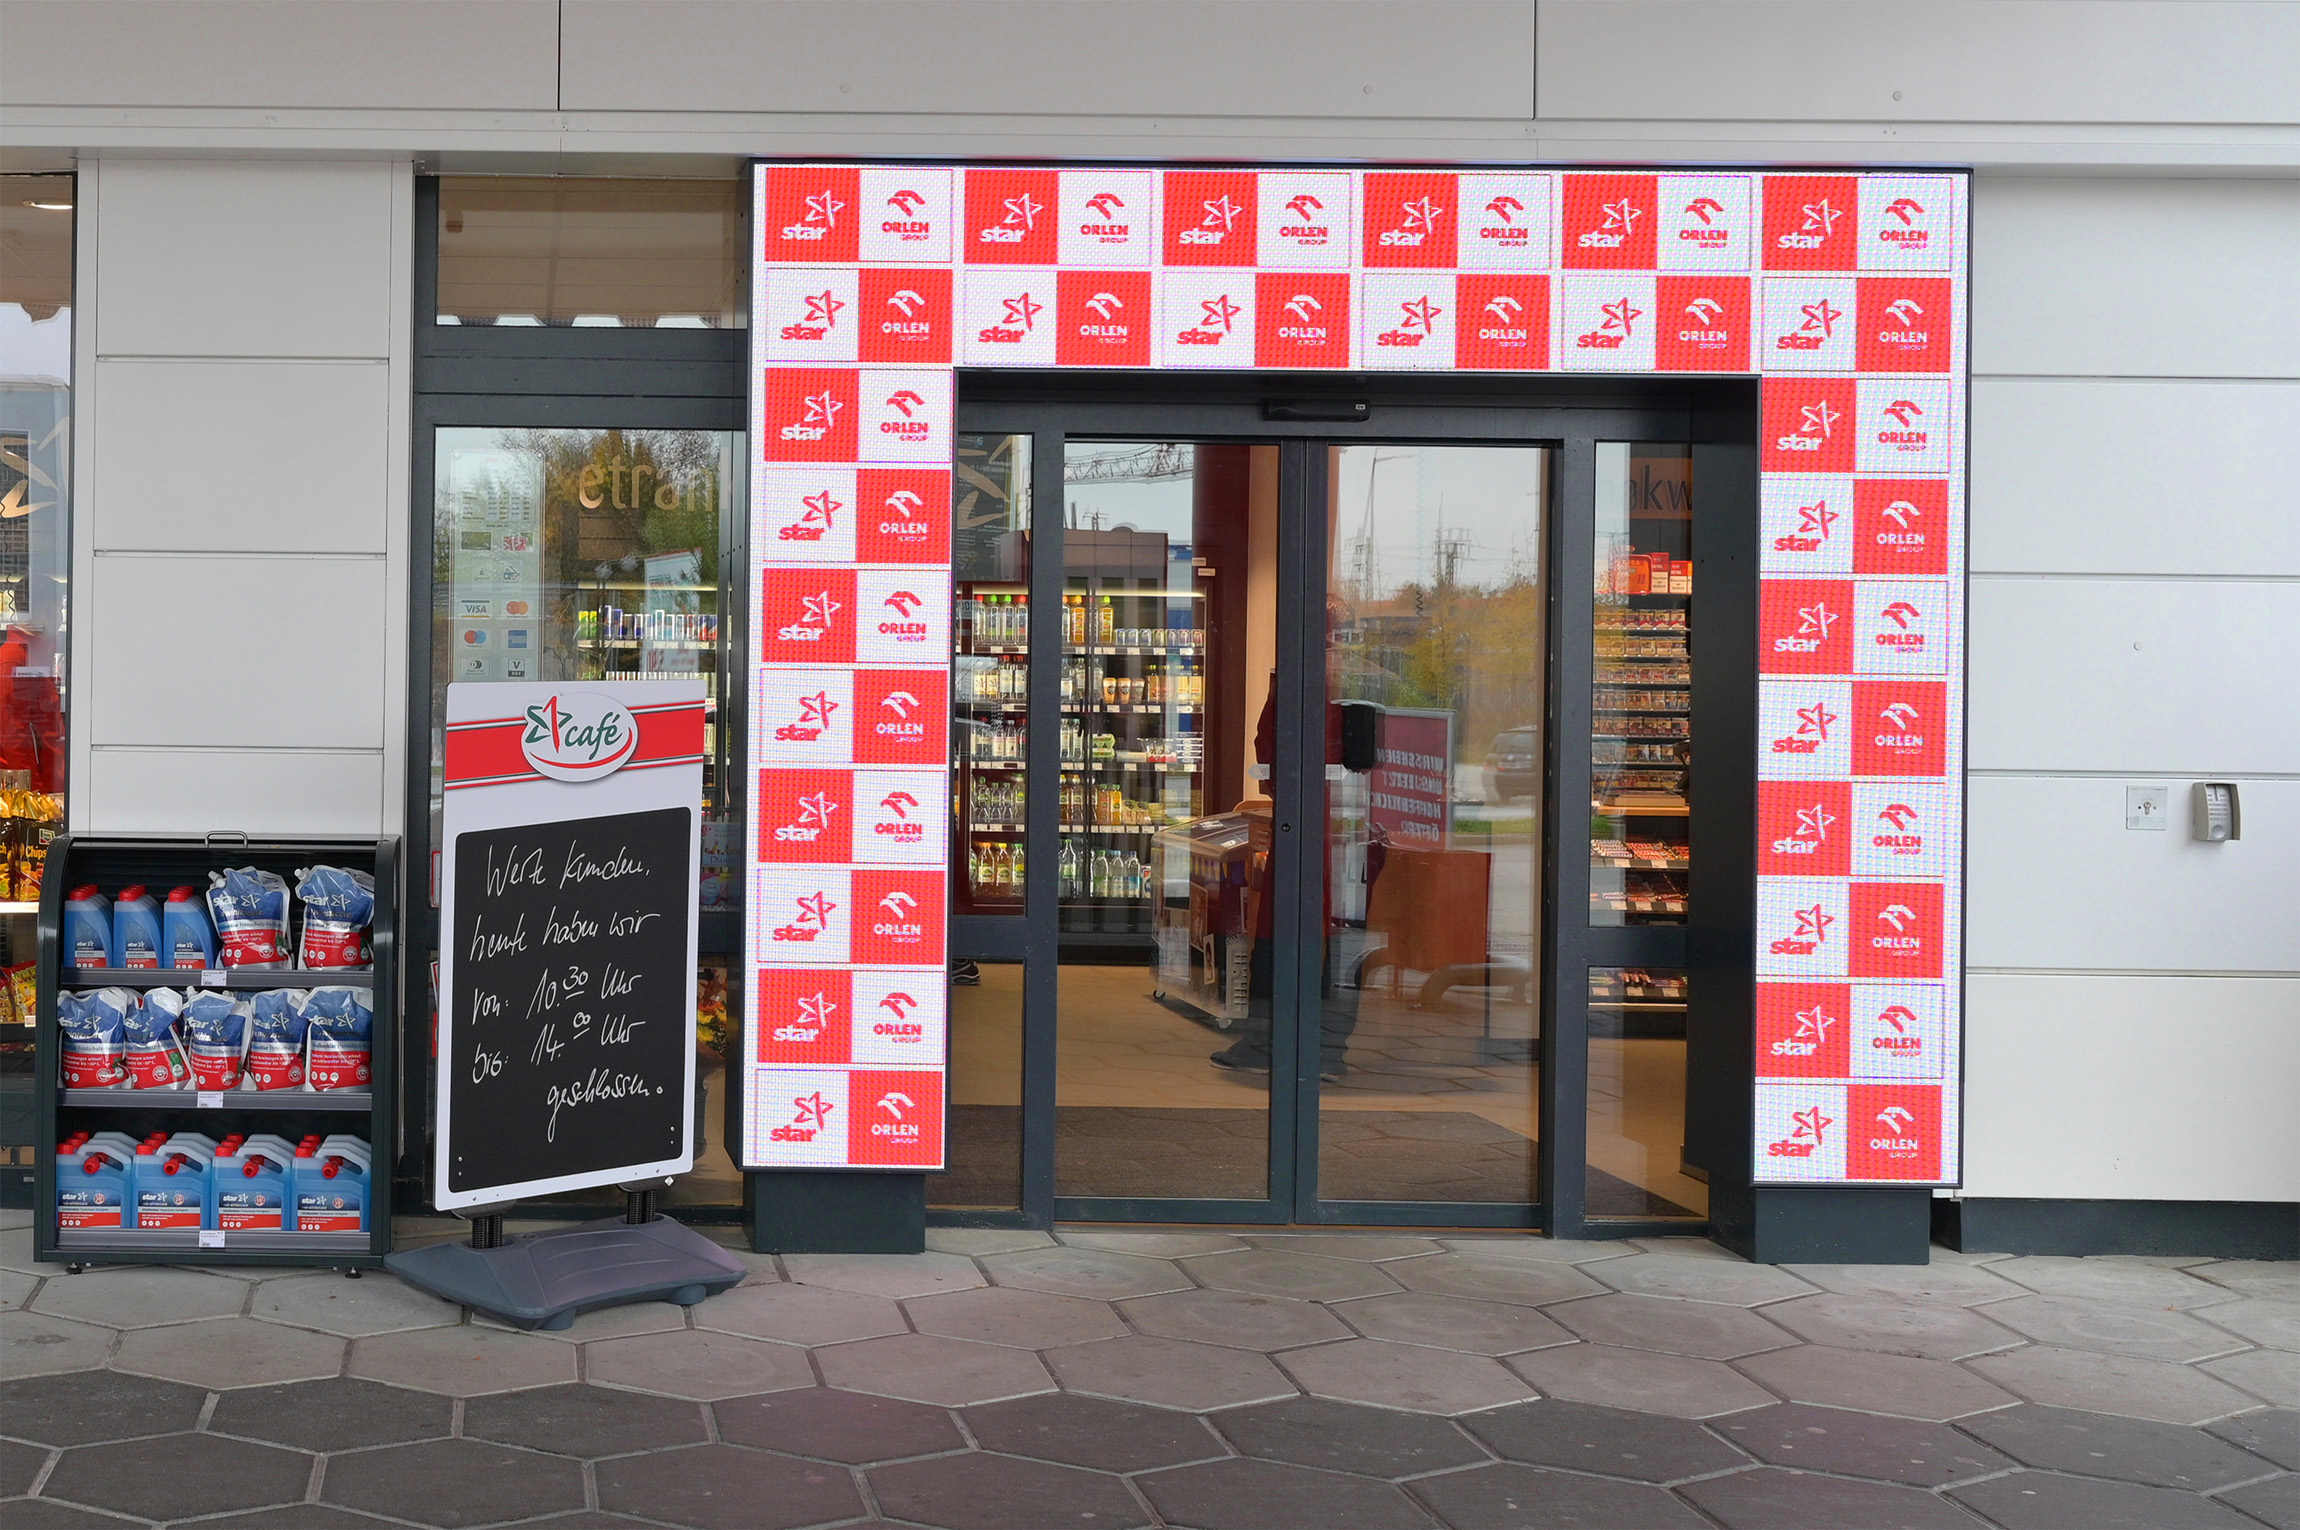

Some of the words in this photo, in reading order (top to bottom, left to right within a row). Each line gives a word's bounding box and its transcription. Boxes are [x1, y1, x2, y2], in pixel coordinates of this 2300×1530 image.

[780, 223, 827, 240] star
[882, 221, 930, 233] ORLEN
[979, 225, 1025, 242] star
[1080, 223, 1128, 235] ORLEN
[1279, 225, 1328, 237] ORLEN
[1480, 227, 1528, 239] ORLEN
[1178, 227, 1225, 244] star
[1378, 229, 1425, 246] star
[1578, 230, 1625, 247] star
[1680, 228, 1728, 240] ORLEN
[1777, 231, 1824, 248] star
[1880, 229, 1928, 241] ORLEN
[781, 323, 827, 340] star
[882, 321, 930, 333] ORLEN
[978, 325, 1025, 342] star
[1079, 323, 1128, 335] ORLEN
[1278, 325, 1327, 337] ORLEN
[1479, 327, 1527, 339] ORLEN
[1177, 327, 1224, 344] star
[1377, 329, 1424, 346] star
[1577, 331, 1624, 348] star
[1679, 329, 1728, 341] ORLEN
[1777, 332, 1824, 349] star
[1879, 330, 1928, 342] ORLEN
[779, 423, 825, 440] star
[880, 421, 928, 433] ORLEN
[1776, 433, 1823, 450] star
[1878, 431, 1927, 443] ORLEN
[778, 523, 825, 540] star
[879, 521, 928, 533] ORLEN
[1774, 533, 1821, 551] star
[1876, 532, 1925, 544] ORLEN
[465, 605, 487, 613] VISA
[777, 623, 823, 641] star
[878, 622, 926, 634] ORLEN
[1773, 634, 1820, 652] star
[1876, 633, 1924, 645] ORLEN
[775, 723, 821, 740] star
[876, 722, 924, 734] ORLEN
[564, 711, 623, 761] café
[1875, 734, 1923, 746] ORLEN
[1772, 735, 1819, 752] star
[773, 823, 820, 840] star
[874, 822, 923, 834] ORLEN
[1770, 836, 1817, 853] star
[1873, 835, 1921, 847] ORLEN
[26, 845, 47, 860] Chips
[213, 894, 238, 906] star
[469, 912, 527, 961] heute
[543, 906, 599, 945] haben
[609, 910, 661, 937] wir
[772, 923, 819, 940] star
[873, 922, 922, 934] ORLEN
[1769, 937, 1816, 954] star
[1872, 936, 1920, 948] ORLEN
[600, 963, 642, 1000] Uhr
[58, 1016, 81, 1028] tar
[186, 1016, 209, 1029] tar
[309, 1014, 334, 1027] tar
[600, 1013, 646, 1046] Uhr
[773, 1024, 819, 1041] star
[874, 1023, 922, 1035] ORLEN
[1770, 1038, 1817, 1055] star
[1873, 1037, 1921, 1049] ORLEN
[770, 1124, 816, 1141] star
[871, 1123, 919, 1135] ORLEN
[1766, 1138, 1814, 1155] star
[1869, 1137, 1918, 1149] ORLEN
[142, 1193, 157, 1201] star
[301, 1197, 316, 1205] star
